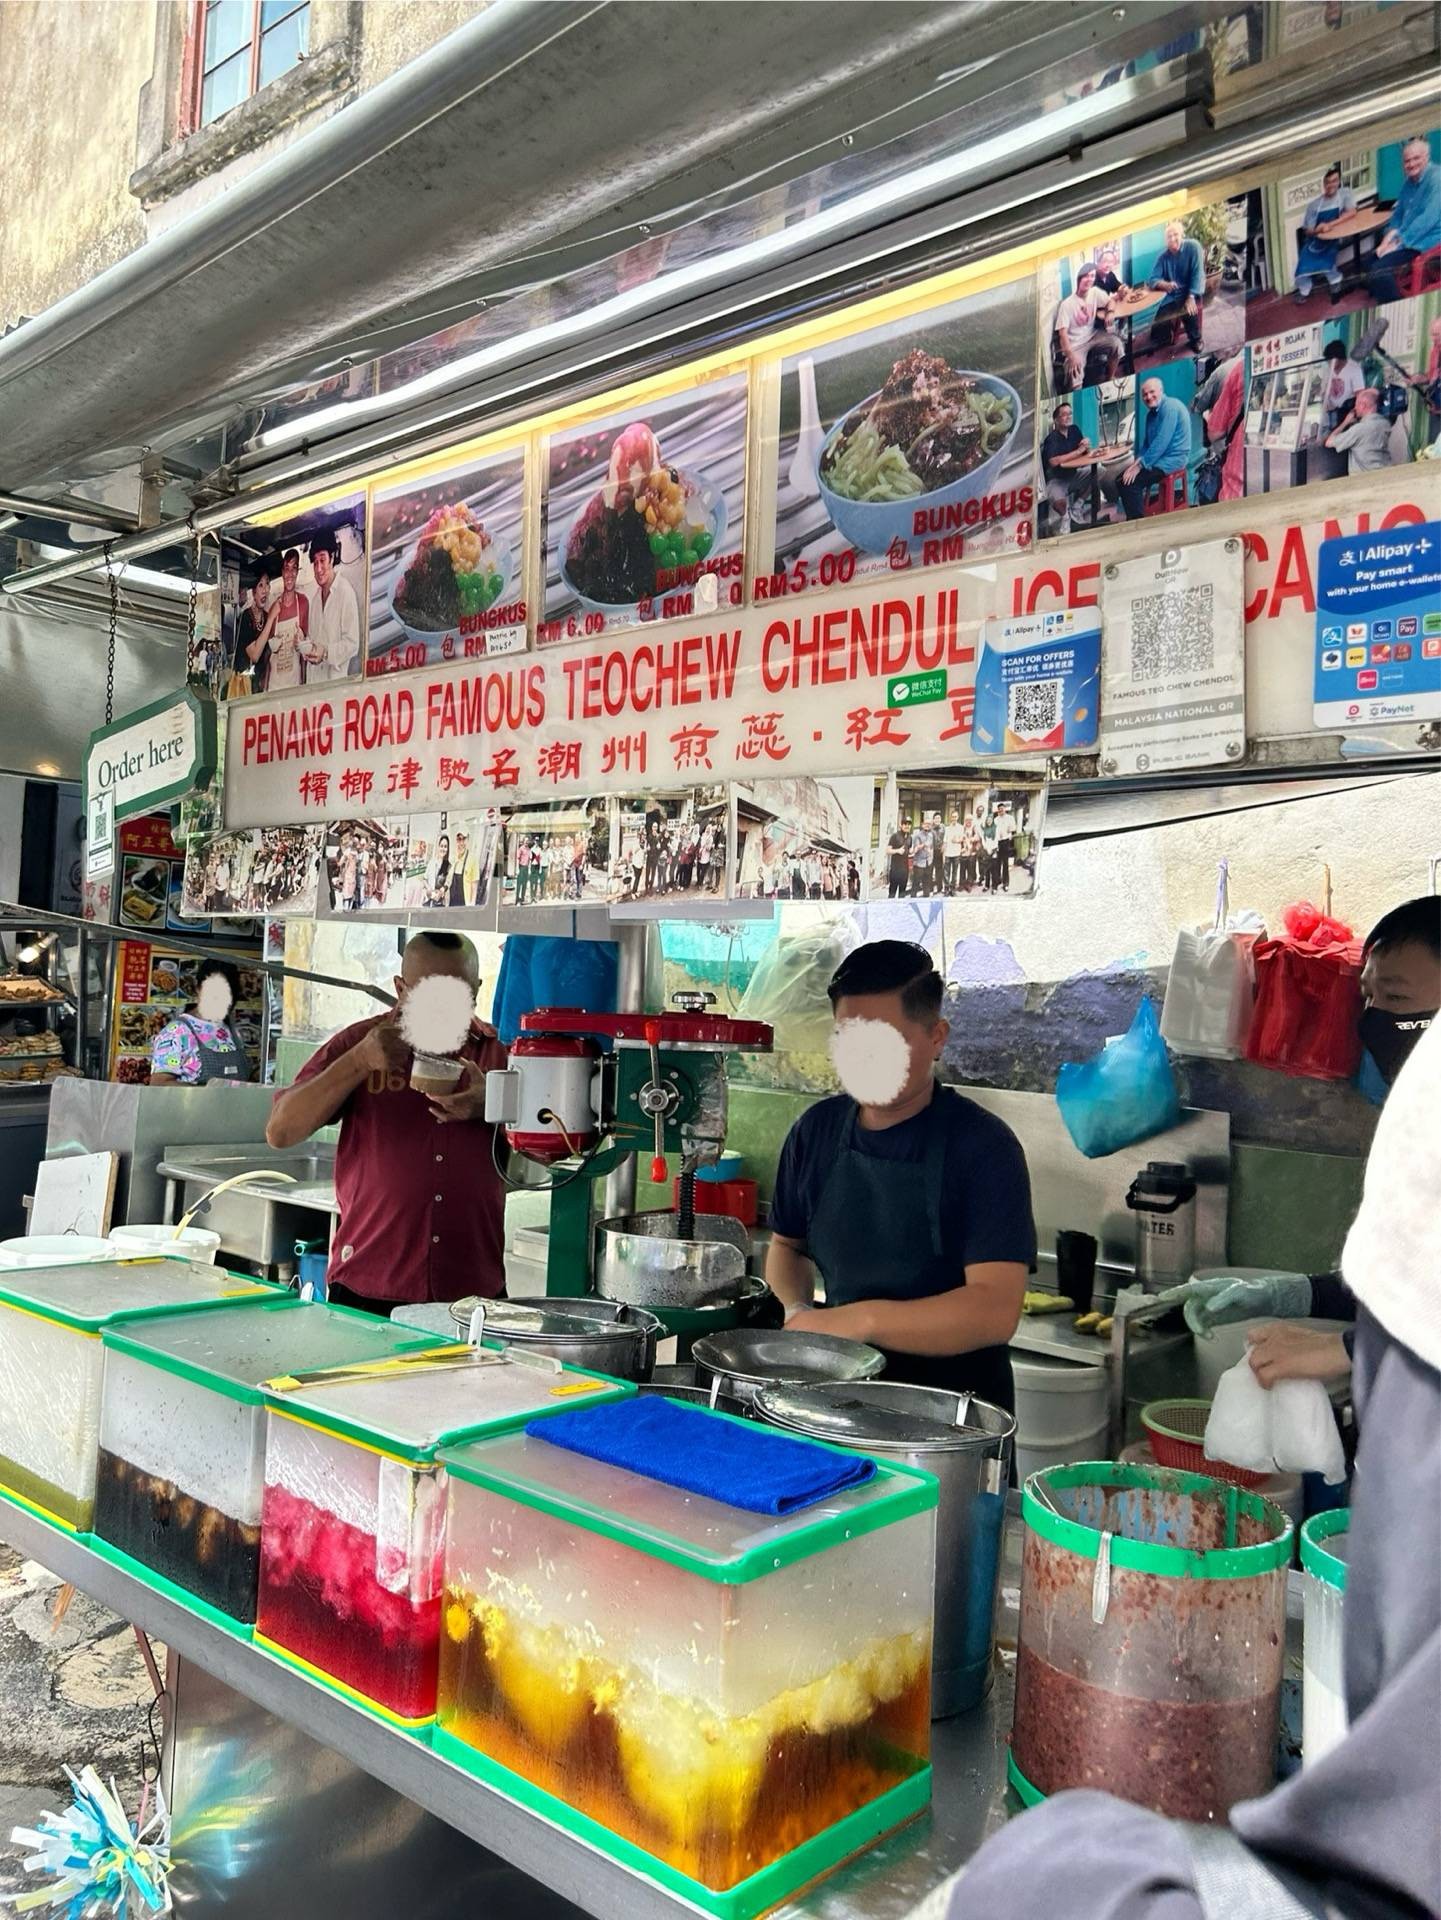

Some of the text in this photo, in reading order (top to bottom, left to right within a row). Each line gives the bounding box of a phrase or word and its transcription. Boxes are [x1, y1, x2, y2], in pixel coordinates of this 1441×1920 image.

[1281, 347, 1308, 362] DESSERT
[913, 486, 1033, 536] BUNGKUS
[923, 534, 964, 567] RM
[656, 553, 743, 591] BUNGKUS
[1356, 564, 1414, 581] Pay smart
[1327, 587, 1347, 597] with
[1348, 585, 1368, 596] your
[1370, 581, 1398, 591] home
[459, 601, 527, 635] BUNGKUS
[663, 593, 693, 619] RM
[1001, 650, 1075, 668] SCAN FOR OFFERS
[243, 702, 334, 766] PENANG
[344, 689, 414, 752] ROAD
[426, 665, 546, 740] FAMOUS
[563, 630, 742, 720] TEOCHEW
[761, 589, 975, 693] CHENDUL
[1113, 674, 1235, 700] FAMOUS TEO CHEW CHENDOL
[1114, 702, 1234, 728] MALAYSIA NATIONAL QR
[1381, 705, 1414, 715] PayNet
[98, 736, 184, 788] Order here
